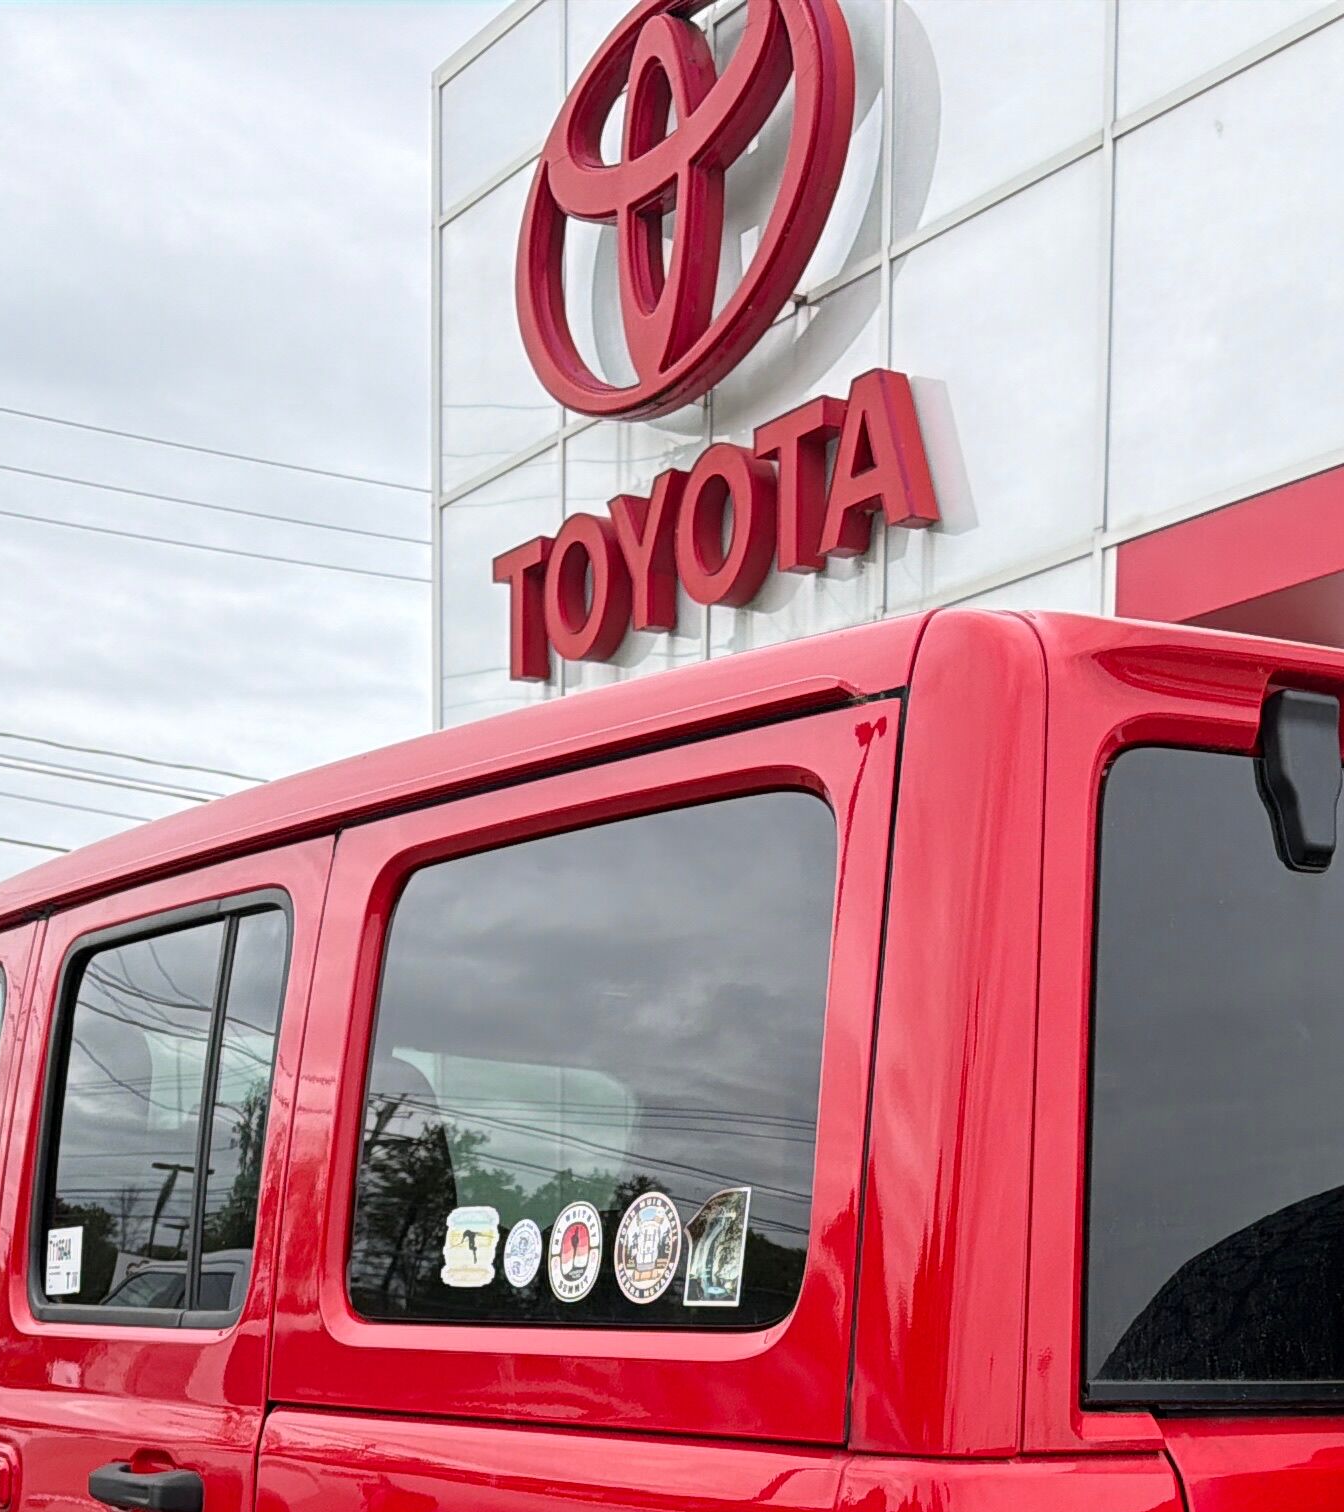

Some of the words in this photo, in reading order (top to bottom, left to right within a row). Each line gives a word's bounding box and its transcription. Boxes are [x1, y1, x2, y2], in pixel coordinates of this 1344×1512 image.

[493, 368, 941, 681] TOYOTA
[565, 1209, 597, 1239] WHITNEY
[619, 1209, 637, 1245] JOHN
[639, 1198, 662, 1210] MUIR
[665, 1204, 678, 1243] TRAIL
[557, 1275, 589, 1295] SUMMIT
[617, 1262, 641, 1298] SIERRA
[643, 1262, 675, 1297] NEVADA
